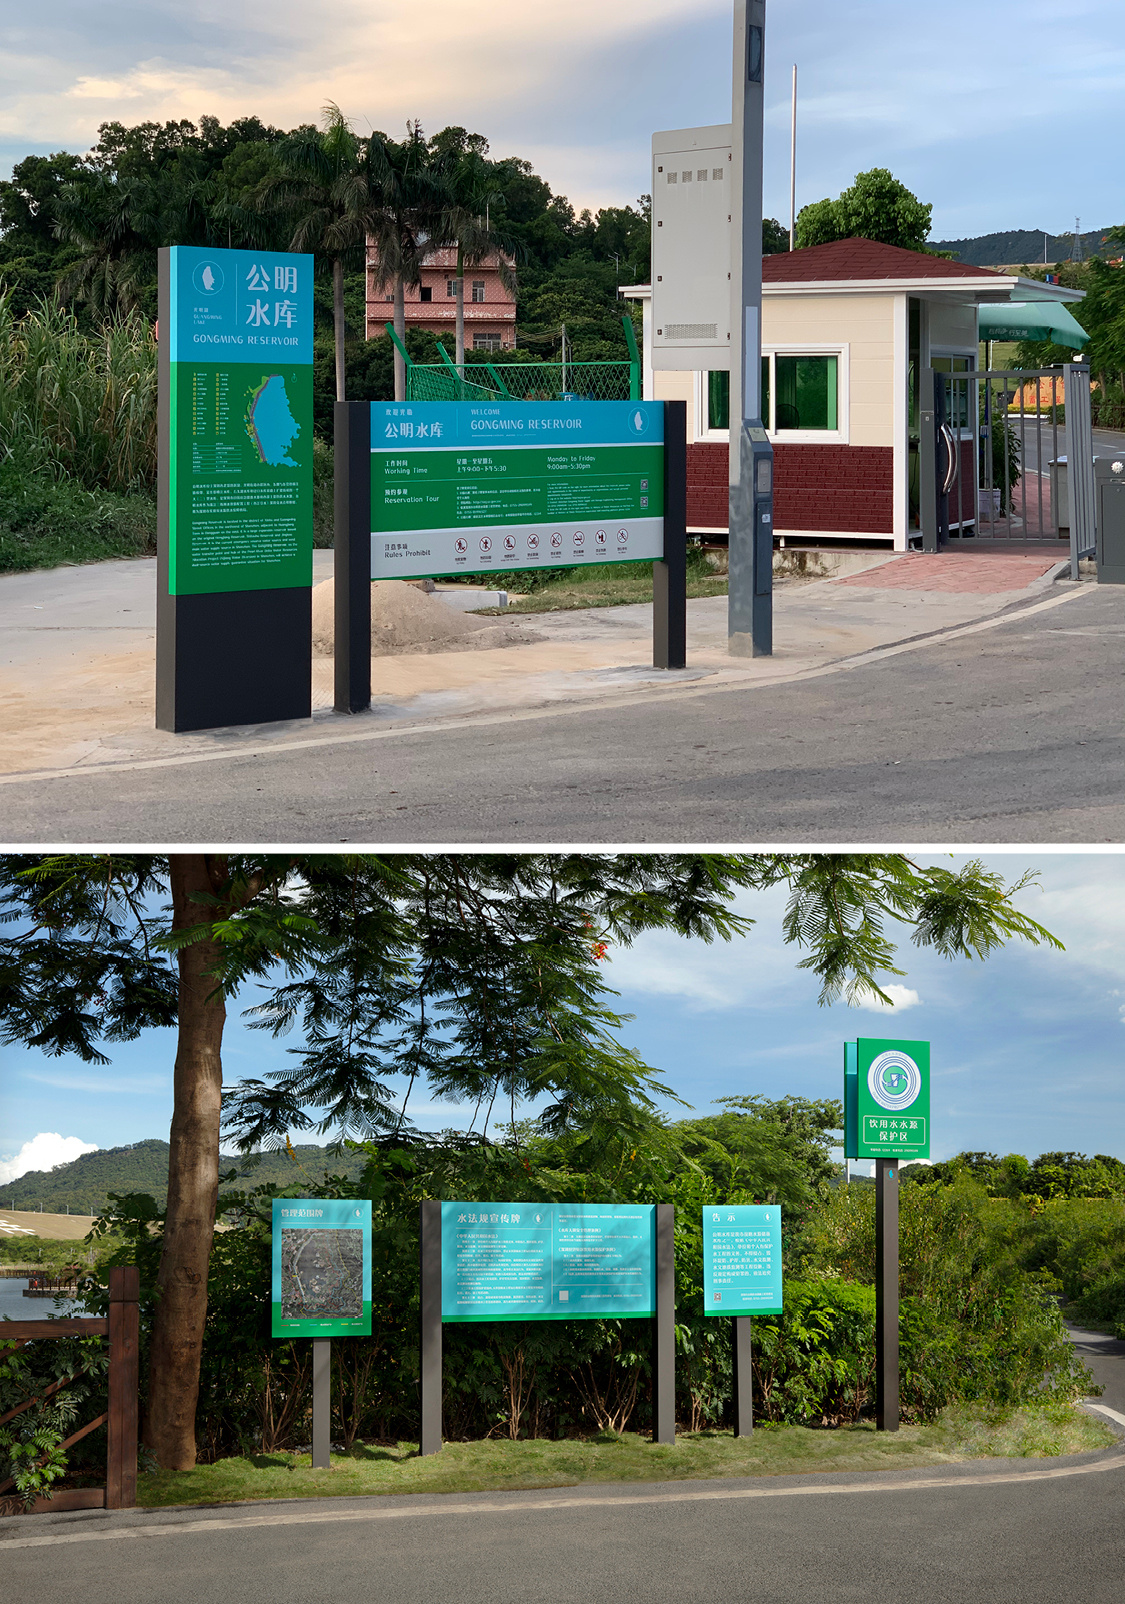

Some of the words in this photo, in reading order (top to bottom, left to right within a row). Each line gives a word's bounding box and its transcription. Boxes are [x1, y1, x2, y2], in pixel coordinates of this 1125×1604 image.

[246, 264, 297, 293] 公明
[246, 299, 297, 328] 水库
[193, 334, 243, 344] GONGMING
[247, 335, 299, 346] RESERVOIR
[470, 420, 524, 430] GONGMING
[528, 419, 582, 429] RESERVOIR
[384, 422, 444, 438] 公明水库
[384, 496, 423, 504] Reservation
[405, 549, 431, 557] Prohibit
[869, 1119, 918, 1129] 饮用水水源
[879, 1132, 908, 1141] 保护区
[281, 1209, 324, 1217] 管理范围牌
[457, 1213, 520, 1223] 水法规宣传牌
[712, 1213, 736, 1222] 告示
